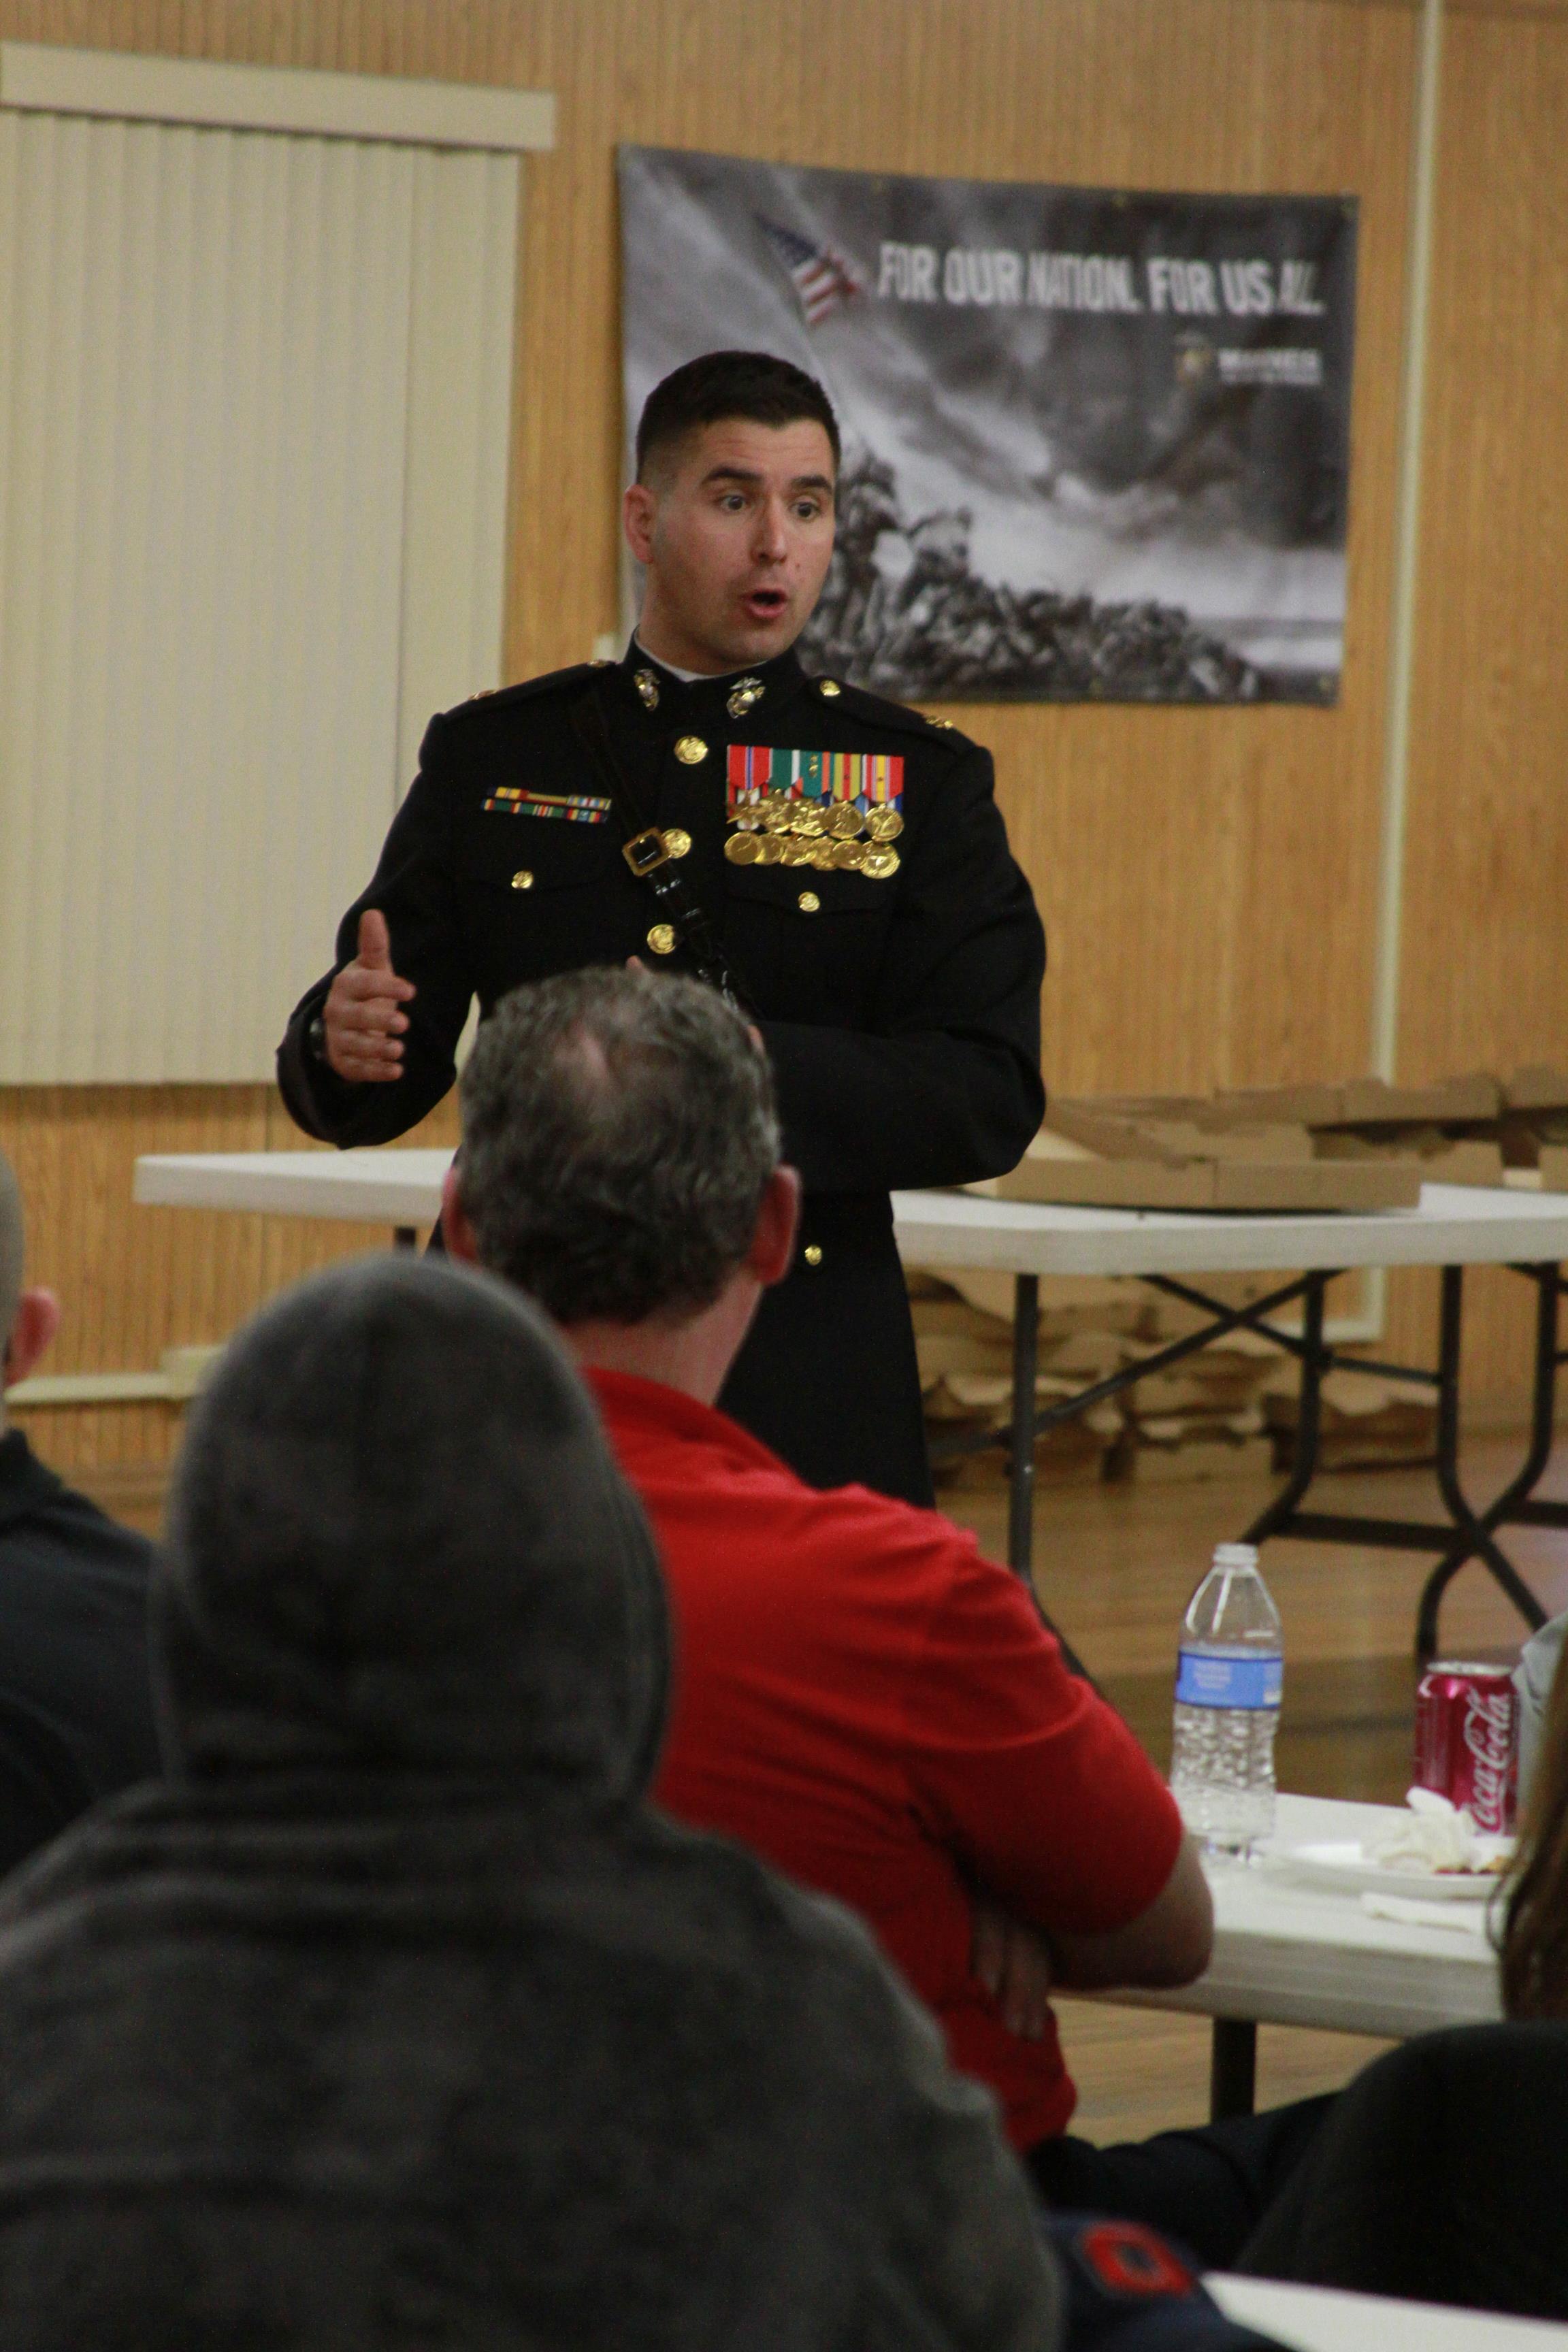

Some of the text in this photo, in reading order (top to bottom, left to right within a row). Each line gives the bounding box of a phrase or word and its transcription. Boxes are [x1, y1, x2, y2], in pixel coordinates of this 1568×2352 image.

[879, 242, 937, 301] FOR
[944, 248, 1022, 306] OUR
[1147, 258, 1217, 314] FOR
[1220, 260, 1273, 314] US
